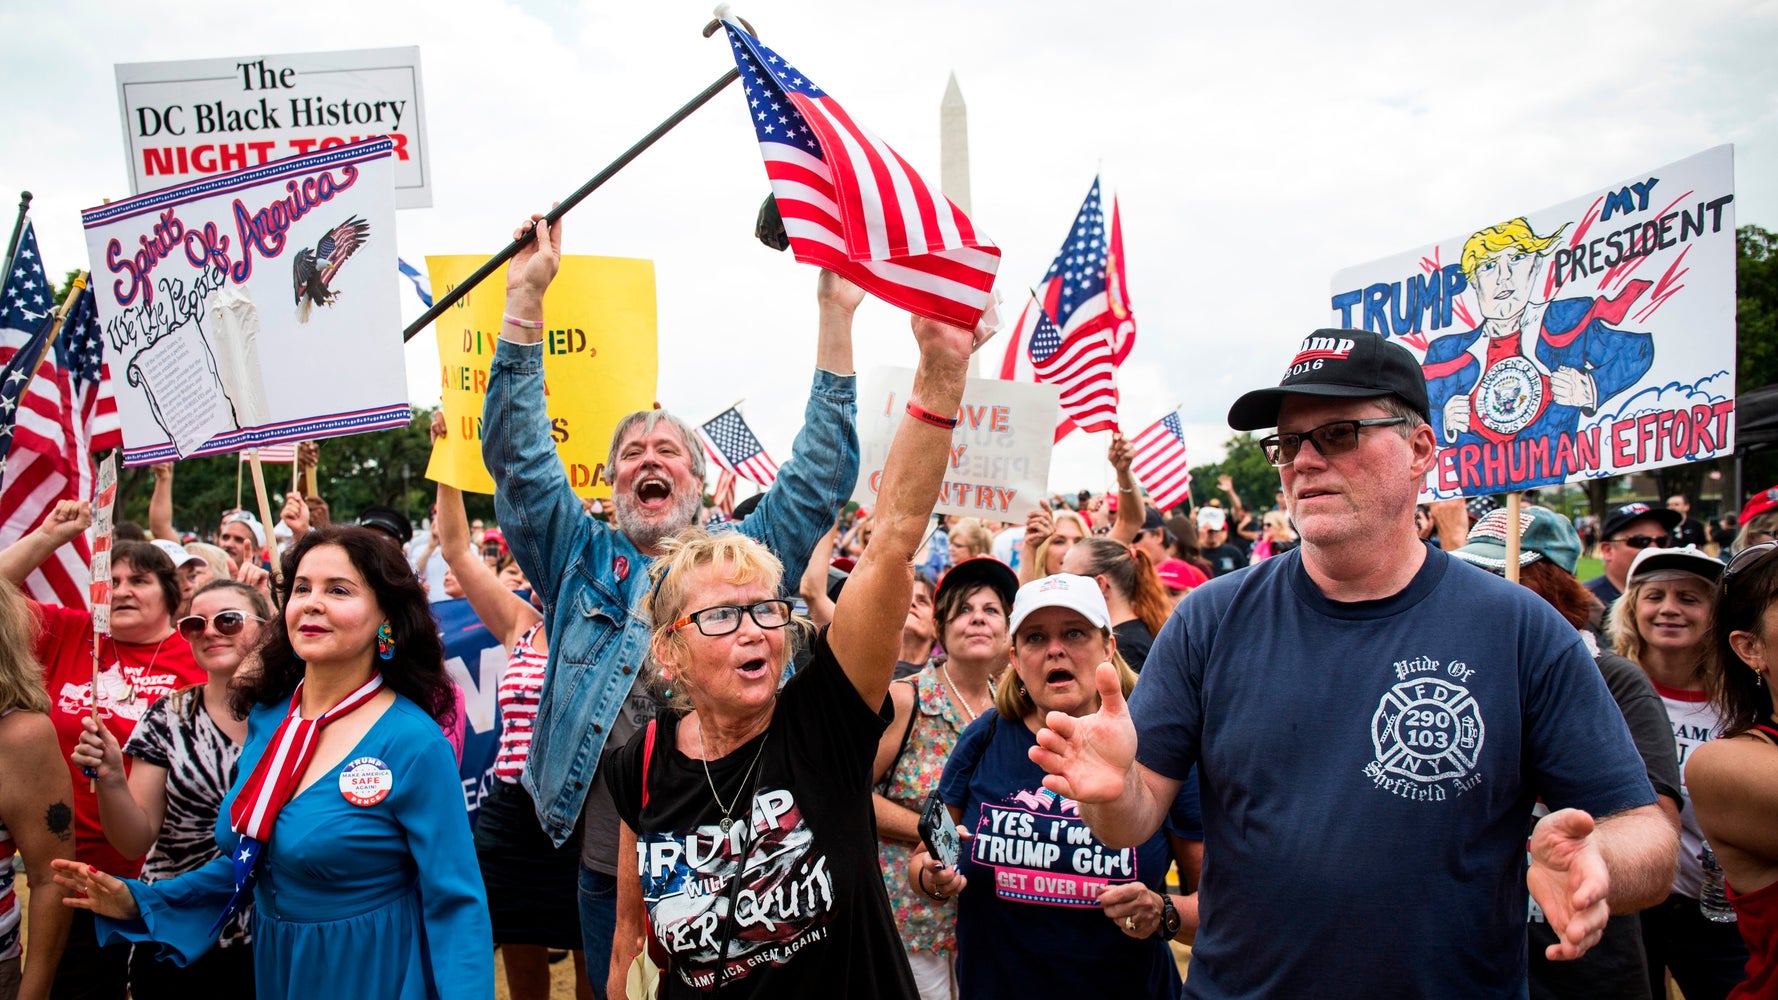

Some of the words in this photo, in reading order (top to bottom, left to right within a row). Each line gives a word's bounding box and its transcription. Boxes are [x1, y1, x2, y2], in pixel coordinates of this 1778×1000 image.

[236, 60, 296, 91] The
[135, 104, 186, 137] DC
[193, 97, 282, 134] Black
[288, 96, 407, 131] History
[142, 141, 276, 176] NIGHT
[289, 133, 410, 161] TR
[1600, 177, 1660, 223] MY
[231, 164, 359, 284] America
[1554, 194, 1734, 288] PRESIDENT
[1331, 263, 1468, 339] TRUMP
[1282, 359, 1324, 380] 2016
[955, 404, 1011, 433] OVE
[1420, 426, 1600, 494] ERHUMAN
[1611, 399, 1735, 468] EFFORT
[130, 674, 177, 686] VOICE
[1393, 655, 1440, 681] Pride
[1447, 659, 1476, 683] Of
[1405, 709, 1450, 728] 290
[1407, 729, 1449, 749] 103
[349, 757, 382, 768] TRUMP
[351, 777, 380, 785] SAFE
[1361, 760, 1446, 802] Sheffield
[351, 795, 381, 805] PENCE
[991, 809, 1039, 841] YES,
[976, 833, 1062, 869] TRUMP
[1072, 845, 1133, 877] Girl
[684, 876, 728, 898] WILL
[997, 871, 1028, 891] GET
[1033, 876, 1077, 897] OVER
[748, 947, 779, 968] GREAT
